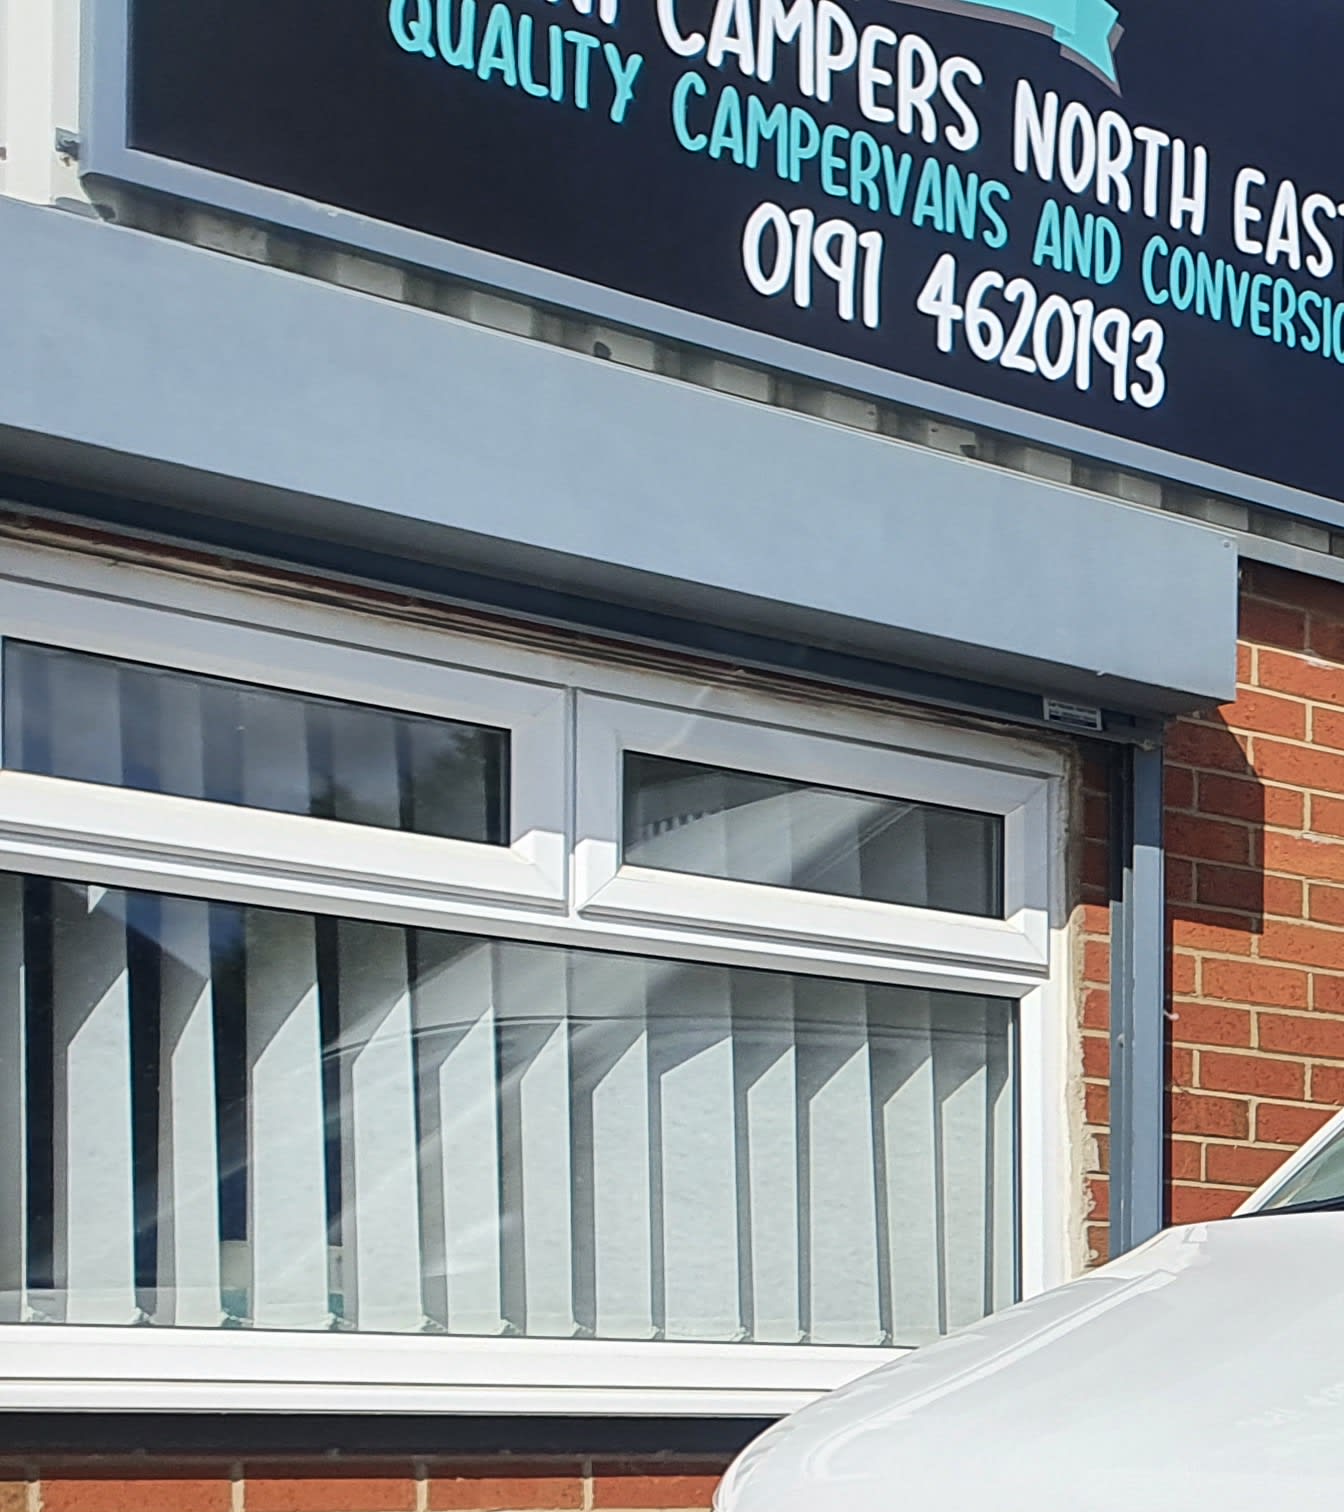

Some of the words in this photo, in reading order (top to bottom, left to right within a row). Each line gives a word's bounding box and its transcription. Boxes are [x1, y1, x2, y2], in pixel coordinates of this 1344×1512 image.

[388, 0, 644, 123] QUALITY
[672, 71, 1011, 249] CAMPERVANS
[1032, 200, 1123, 286] AND
[657, 0, 982, 153] CAMPERS
[1014, 79, 1207, 237] NORTH
[742, 202, 883, 330] 0191
[916, 254, 1167, 409] 4620193
